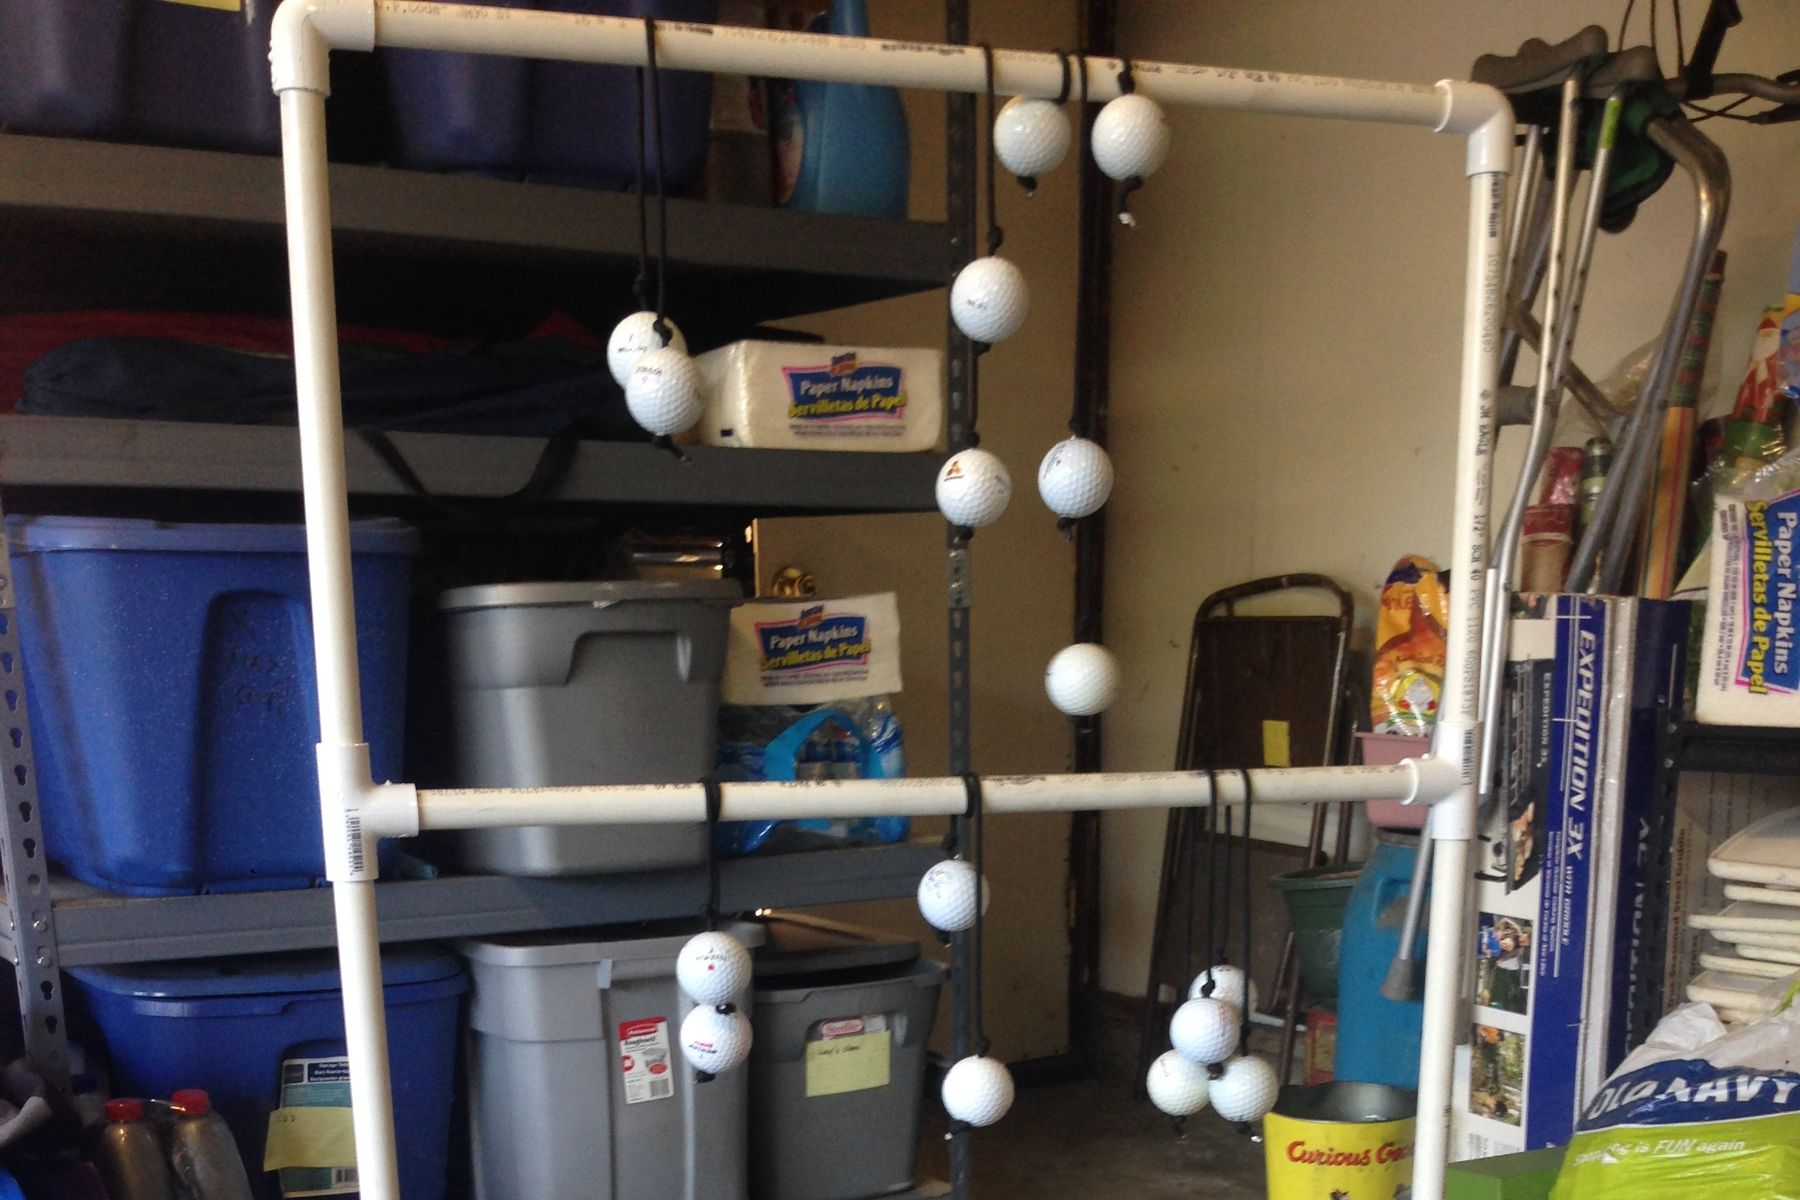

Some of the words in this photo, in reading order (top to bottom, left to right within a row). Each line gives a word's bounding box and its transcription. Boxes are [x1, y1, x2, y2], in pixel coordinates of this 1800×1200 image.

[800, 378, 838, 398] Paper
[841, 375, 894, 394] Napkins
[853, 396, 869, 411] de
[1746, 501, 1773, 604] Servilletas
[1774, 512, 1797, 579] Paper
[770, 633, 805, 650] Paper
[808, 625, 858, 645] Napkins
[1753, 607, 1773, 633] de
[1773, 583, 1797, 674] Napkins
[1746, 635, 1770, 694] Papel
[1569, 629, 1597, 812] EXPEDITION
[1566, 816, 1585, 861] 3X
[1587, 1080, 1659, 1120] OLD
[1662, 1075, 1799, 1104] NAVY
[1286, 1141, 1371, 1167] Curious
[1652, 1139, 1697, 1155] FUN
[1697, 1139, 1746, 1154] again
